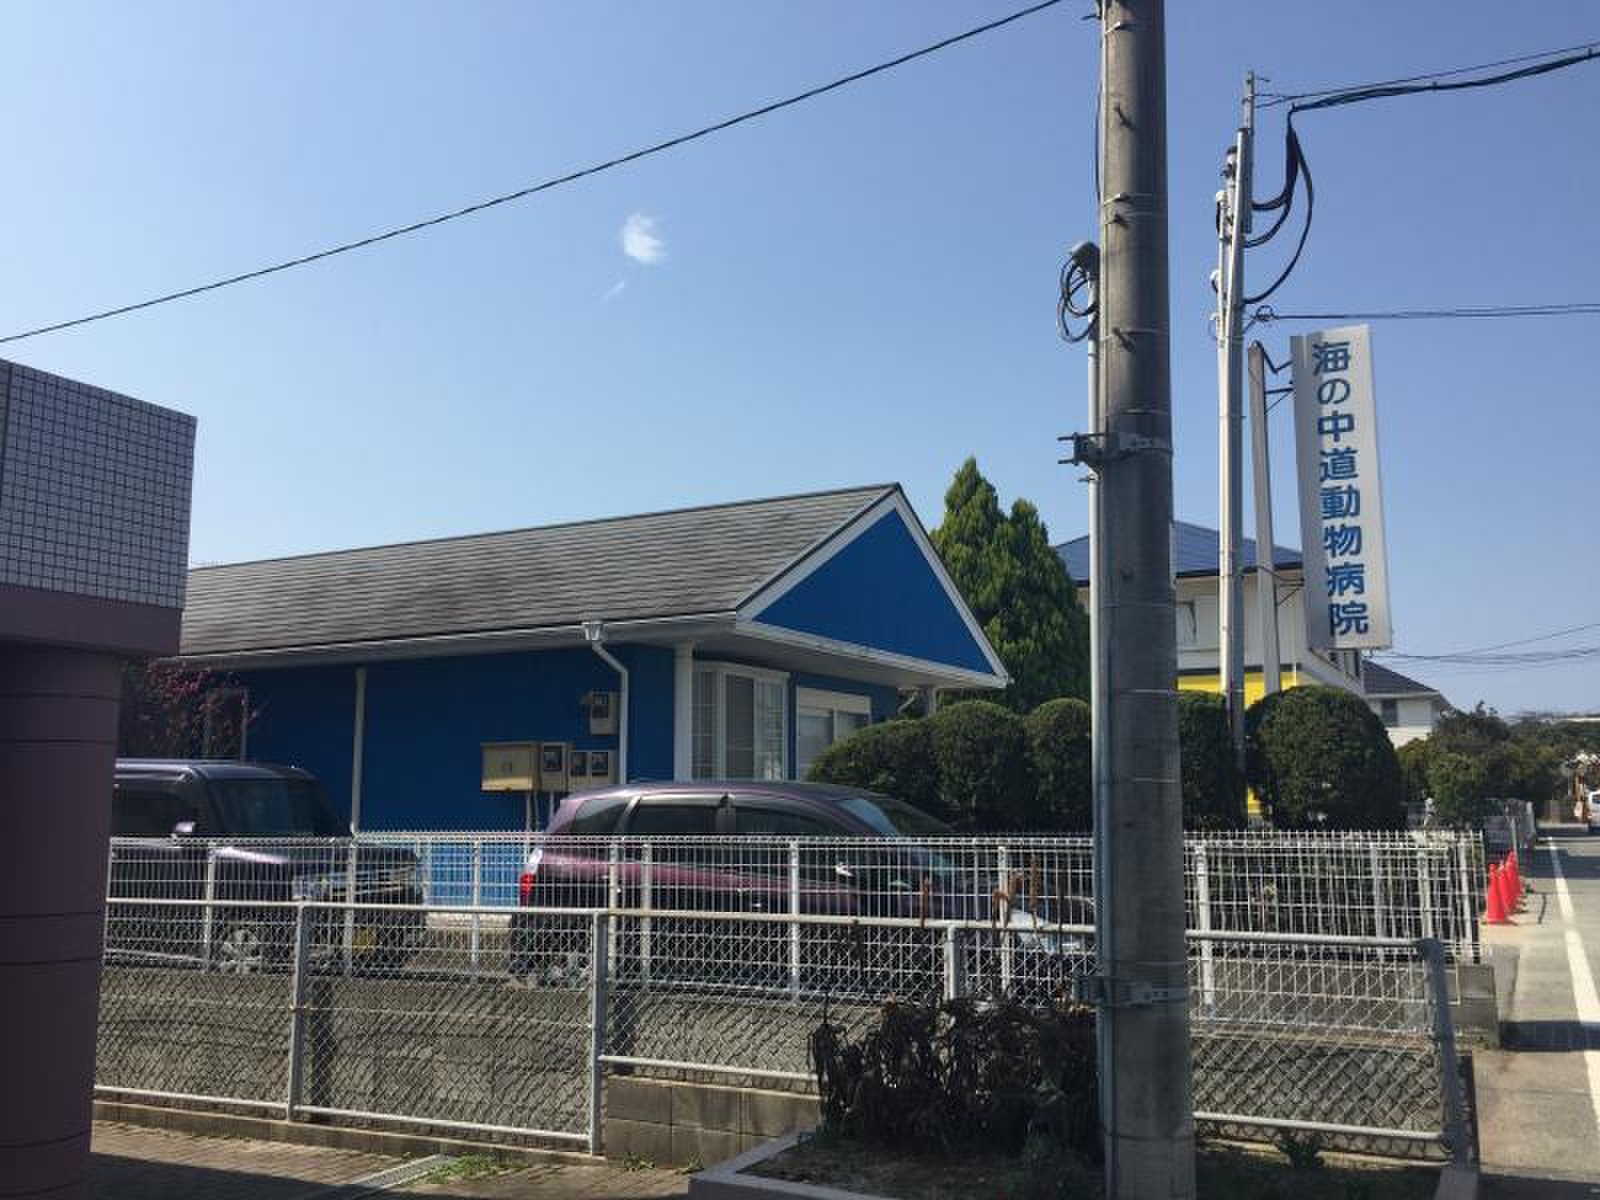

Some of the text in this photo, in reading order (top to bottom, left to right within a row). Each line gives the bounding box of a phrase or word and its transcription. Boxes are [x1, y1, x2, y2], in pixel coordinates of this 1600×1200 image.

[1312, 341, 1369, 636] 海の中道動物病院
